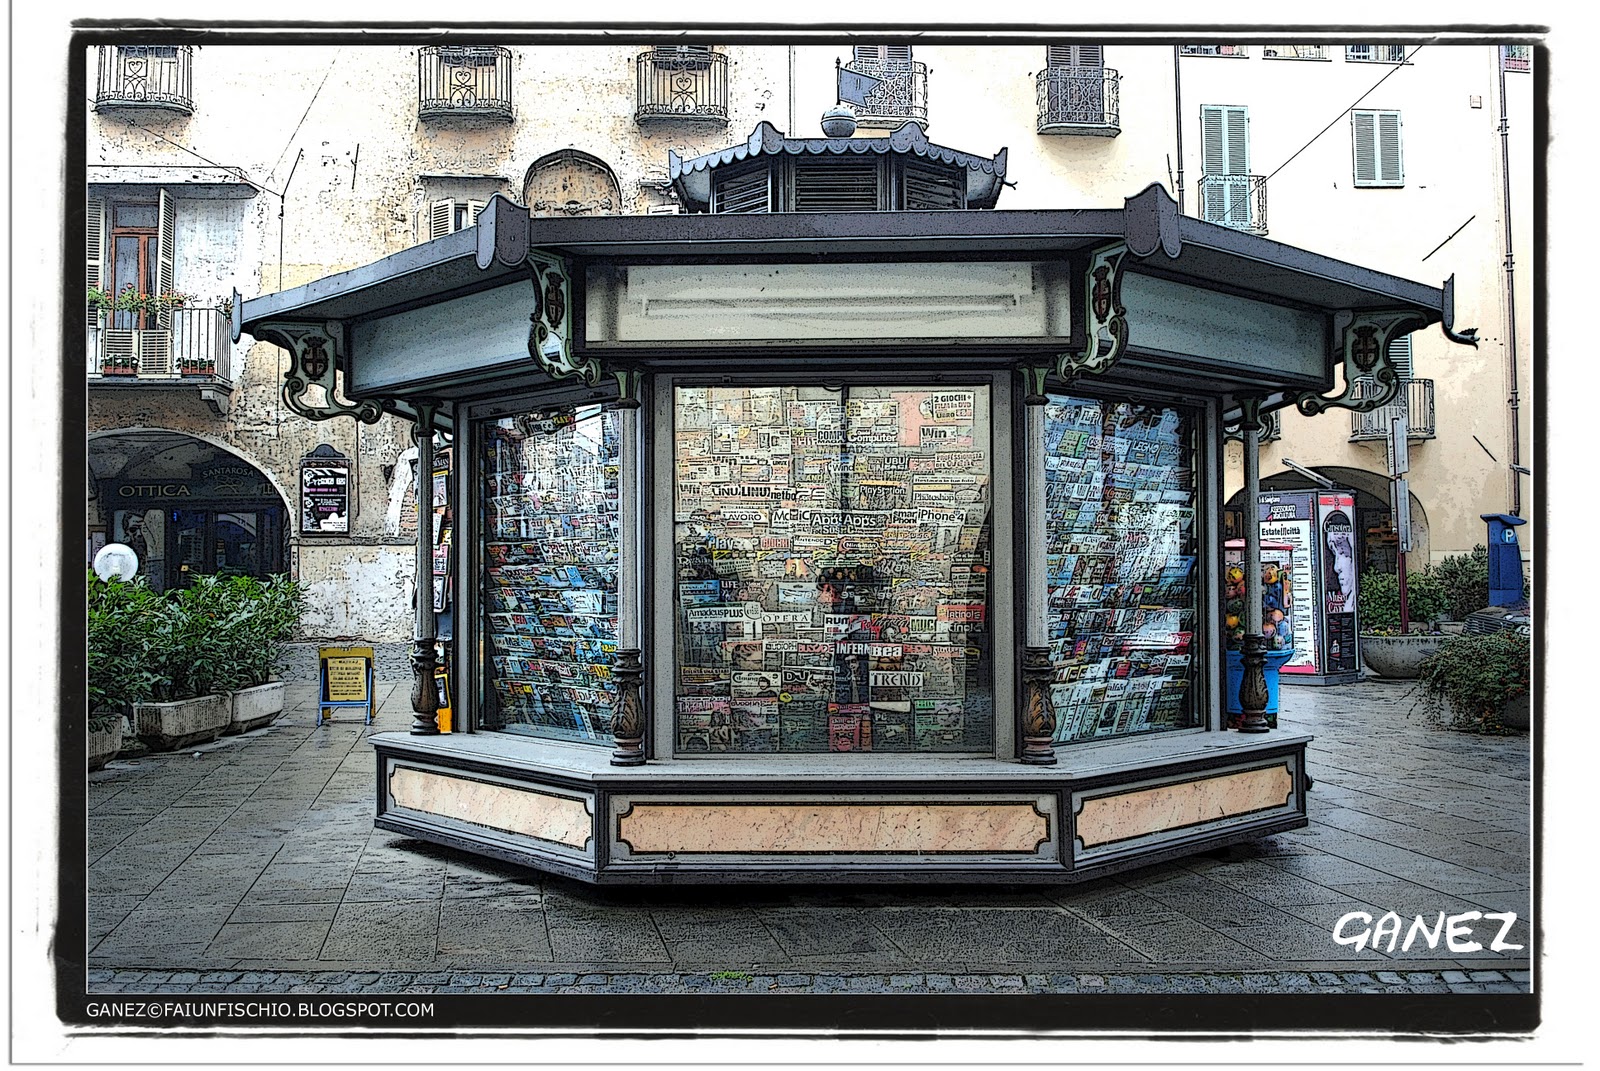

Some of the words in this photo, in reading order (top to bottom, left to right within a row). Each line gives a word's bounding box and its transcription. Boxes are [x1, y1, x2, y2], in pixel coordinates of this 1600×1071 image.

[202, 467, 254, 478] SANTAROSA
[119, 485, 191, 498] OTTICA
[723, 513, 762, 521] LAVORO
[918, 507, 956, 522] iPhone
[1505, 529, 1514, 543] P
[762, 613, 809, 623] OPERA
